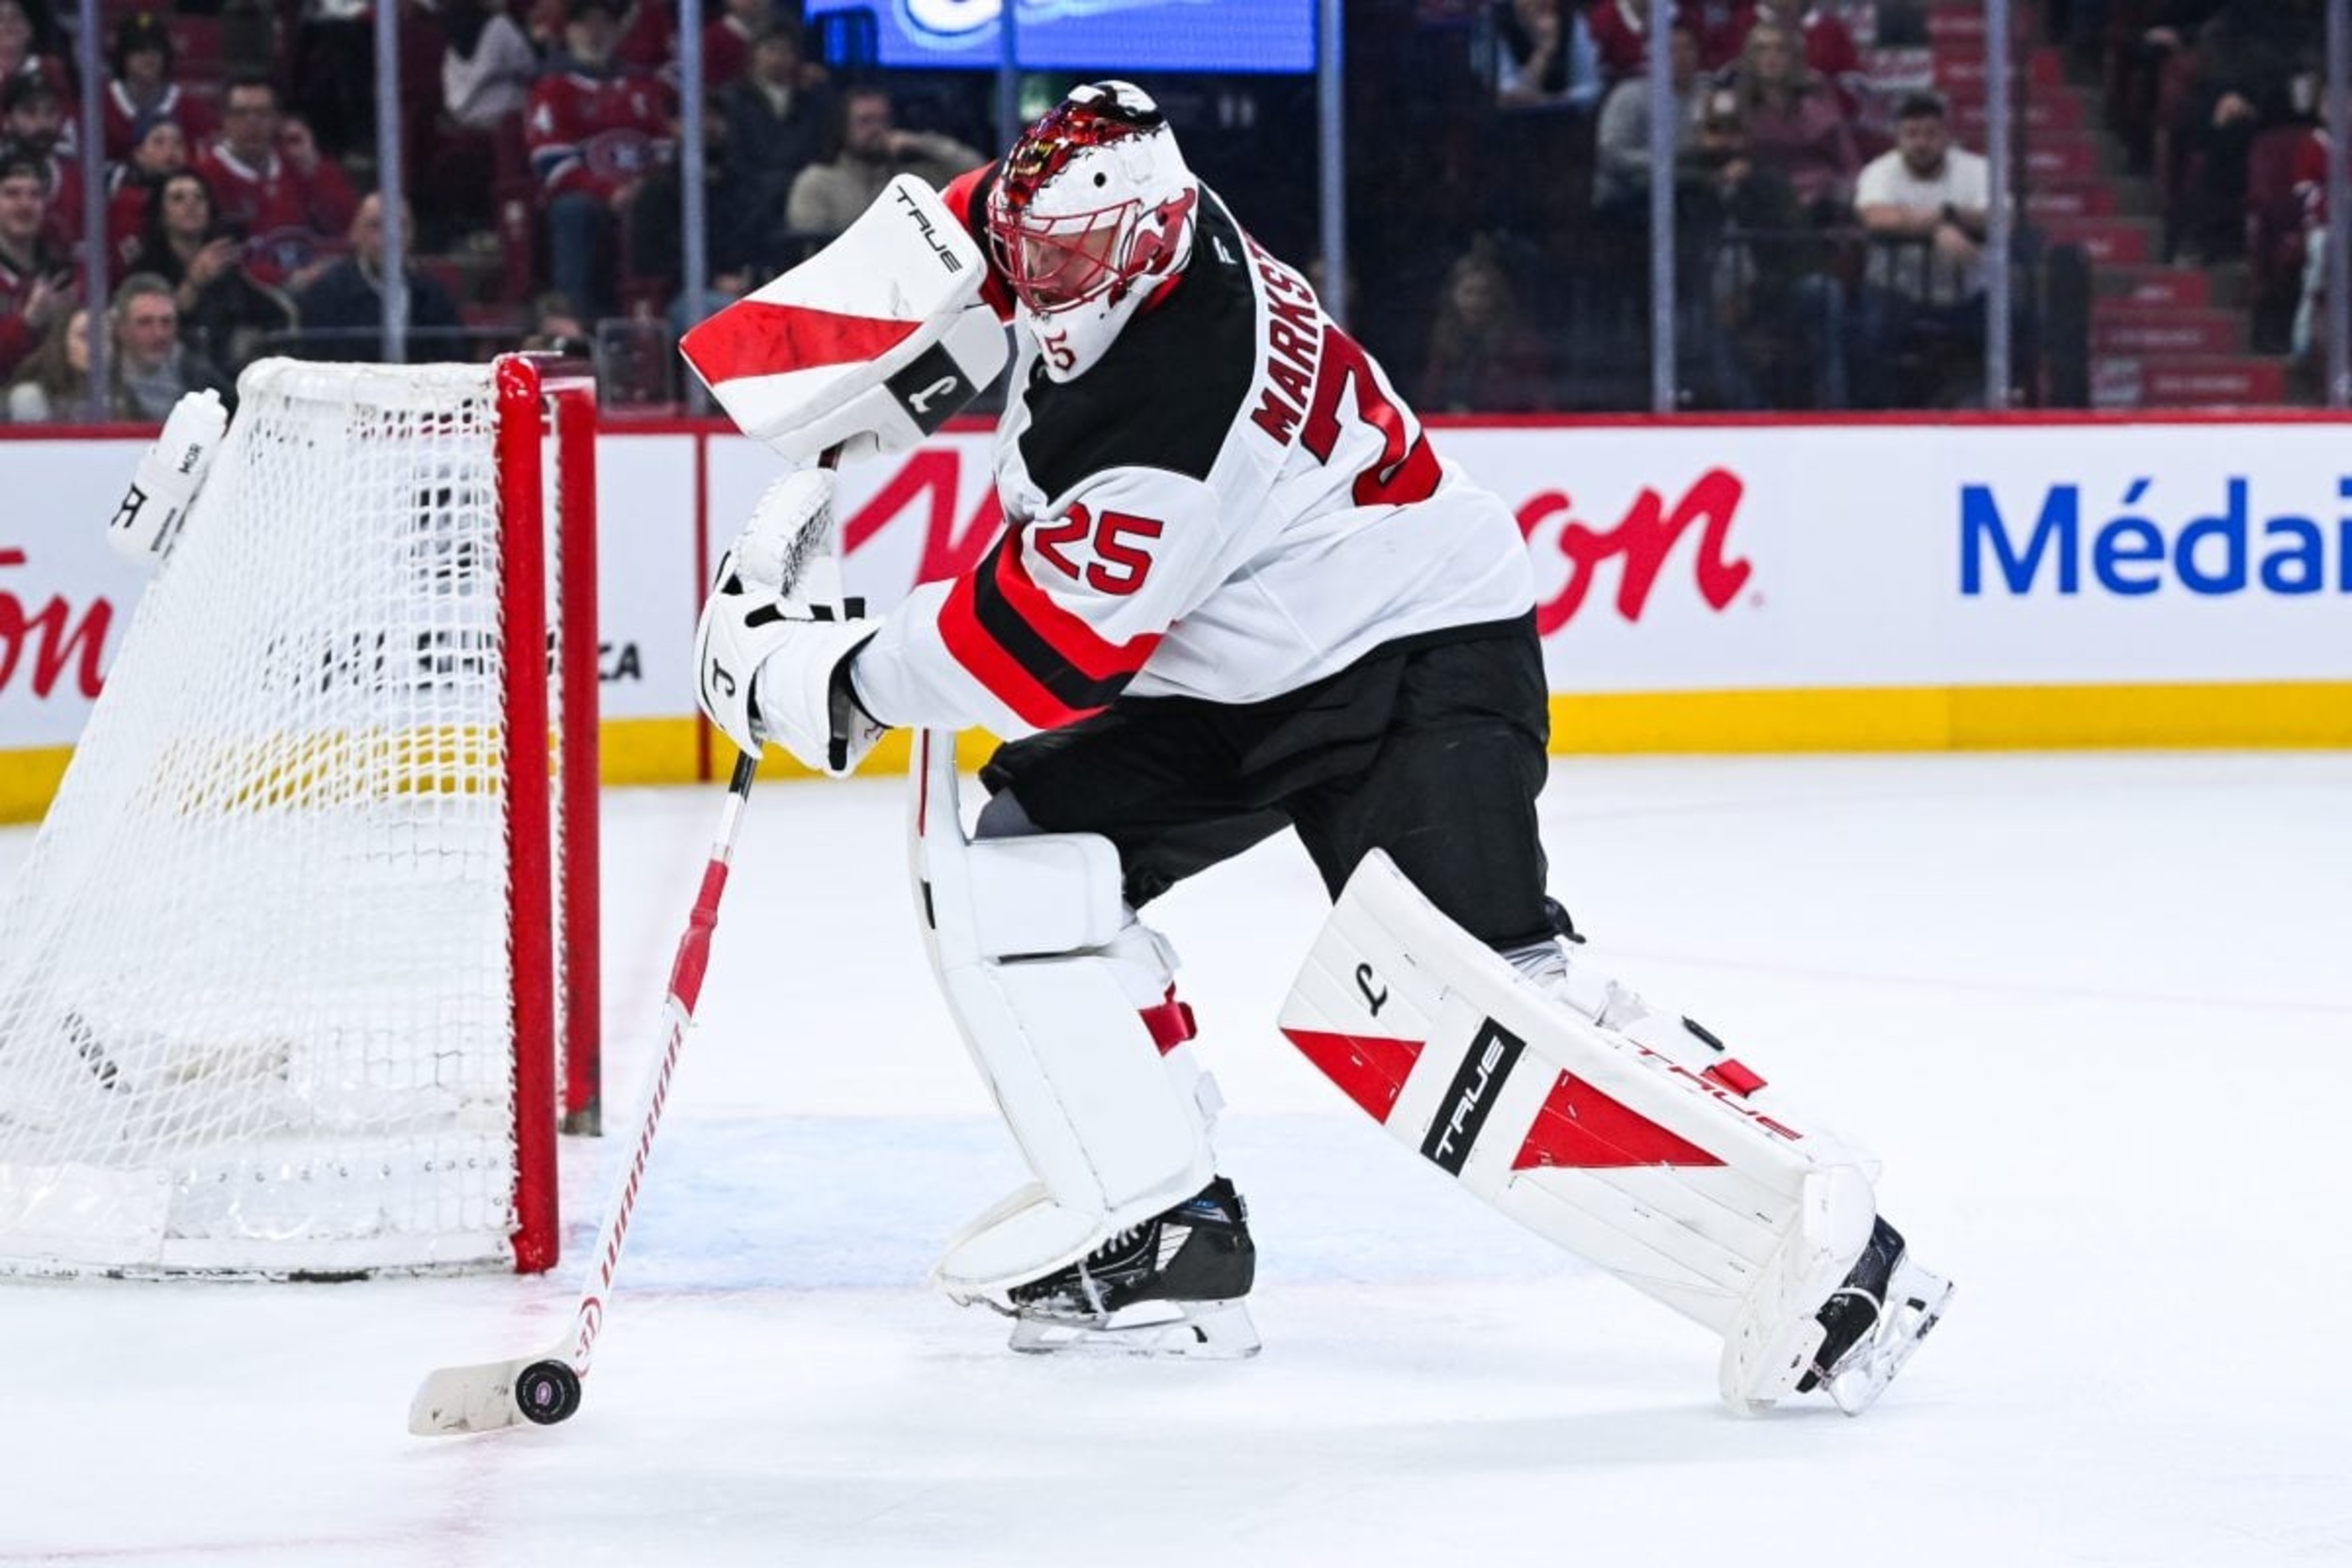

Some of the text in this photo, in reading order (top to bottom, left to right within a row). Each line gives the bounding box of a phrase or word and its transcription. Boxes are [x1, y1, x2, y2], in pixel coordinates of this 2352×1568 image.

[897, 185, 963, 273] TRUE
[1034, 500, 1165, 595] 25
[1960, 476, 2352, 596] Médai
[1434, 1035, 1505, 1160] TRUE
